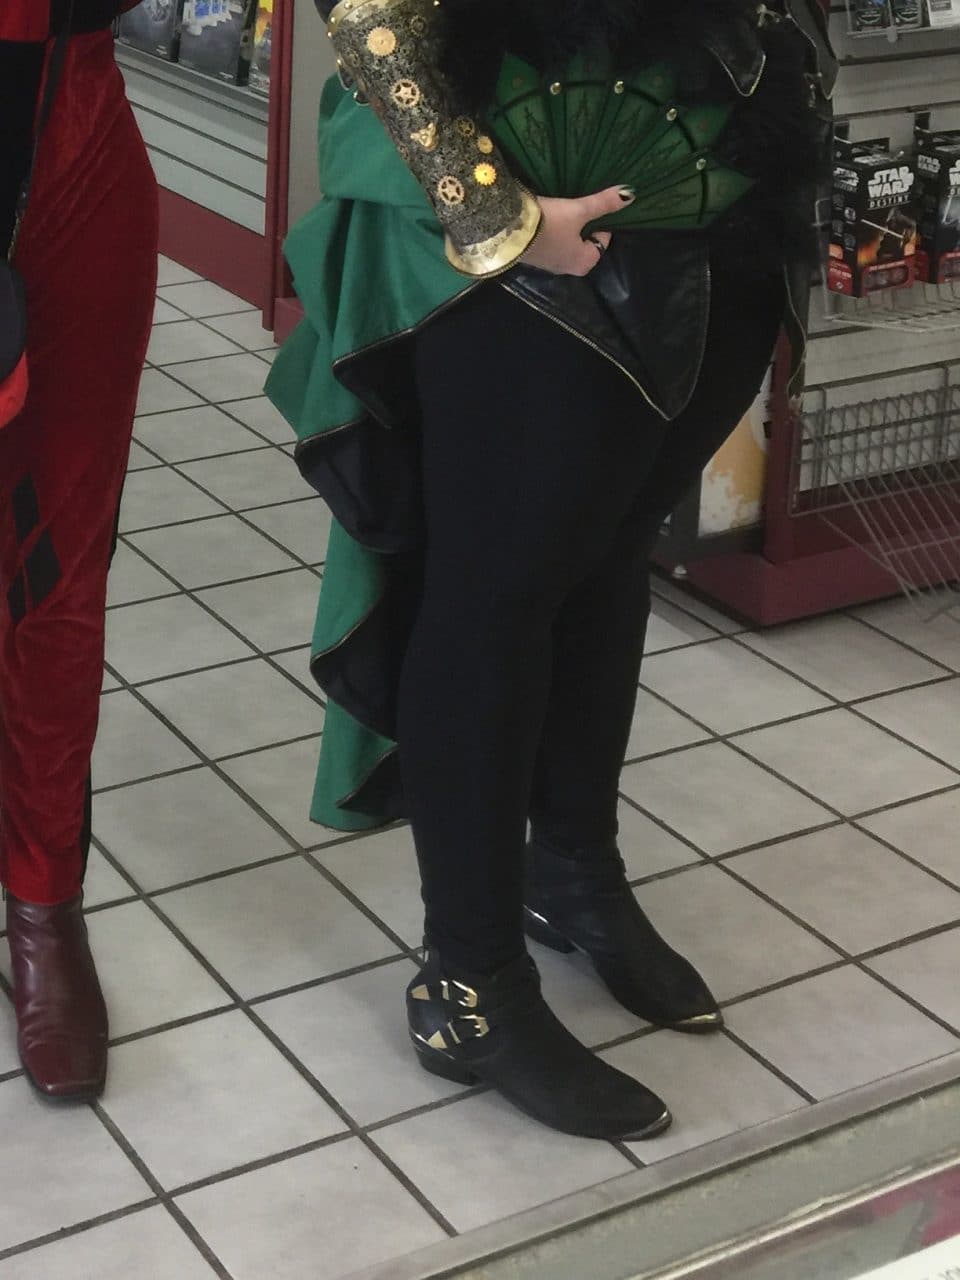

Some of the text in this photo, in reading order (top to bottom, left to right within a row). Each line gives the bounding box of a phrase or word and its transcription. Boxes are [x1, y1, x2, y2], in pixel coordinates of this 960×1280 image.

[868, 166, 913, 185] STAR
[868, 175, 914, 198] WARS
[869, 195, 909, 208] DESTINY
